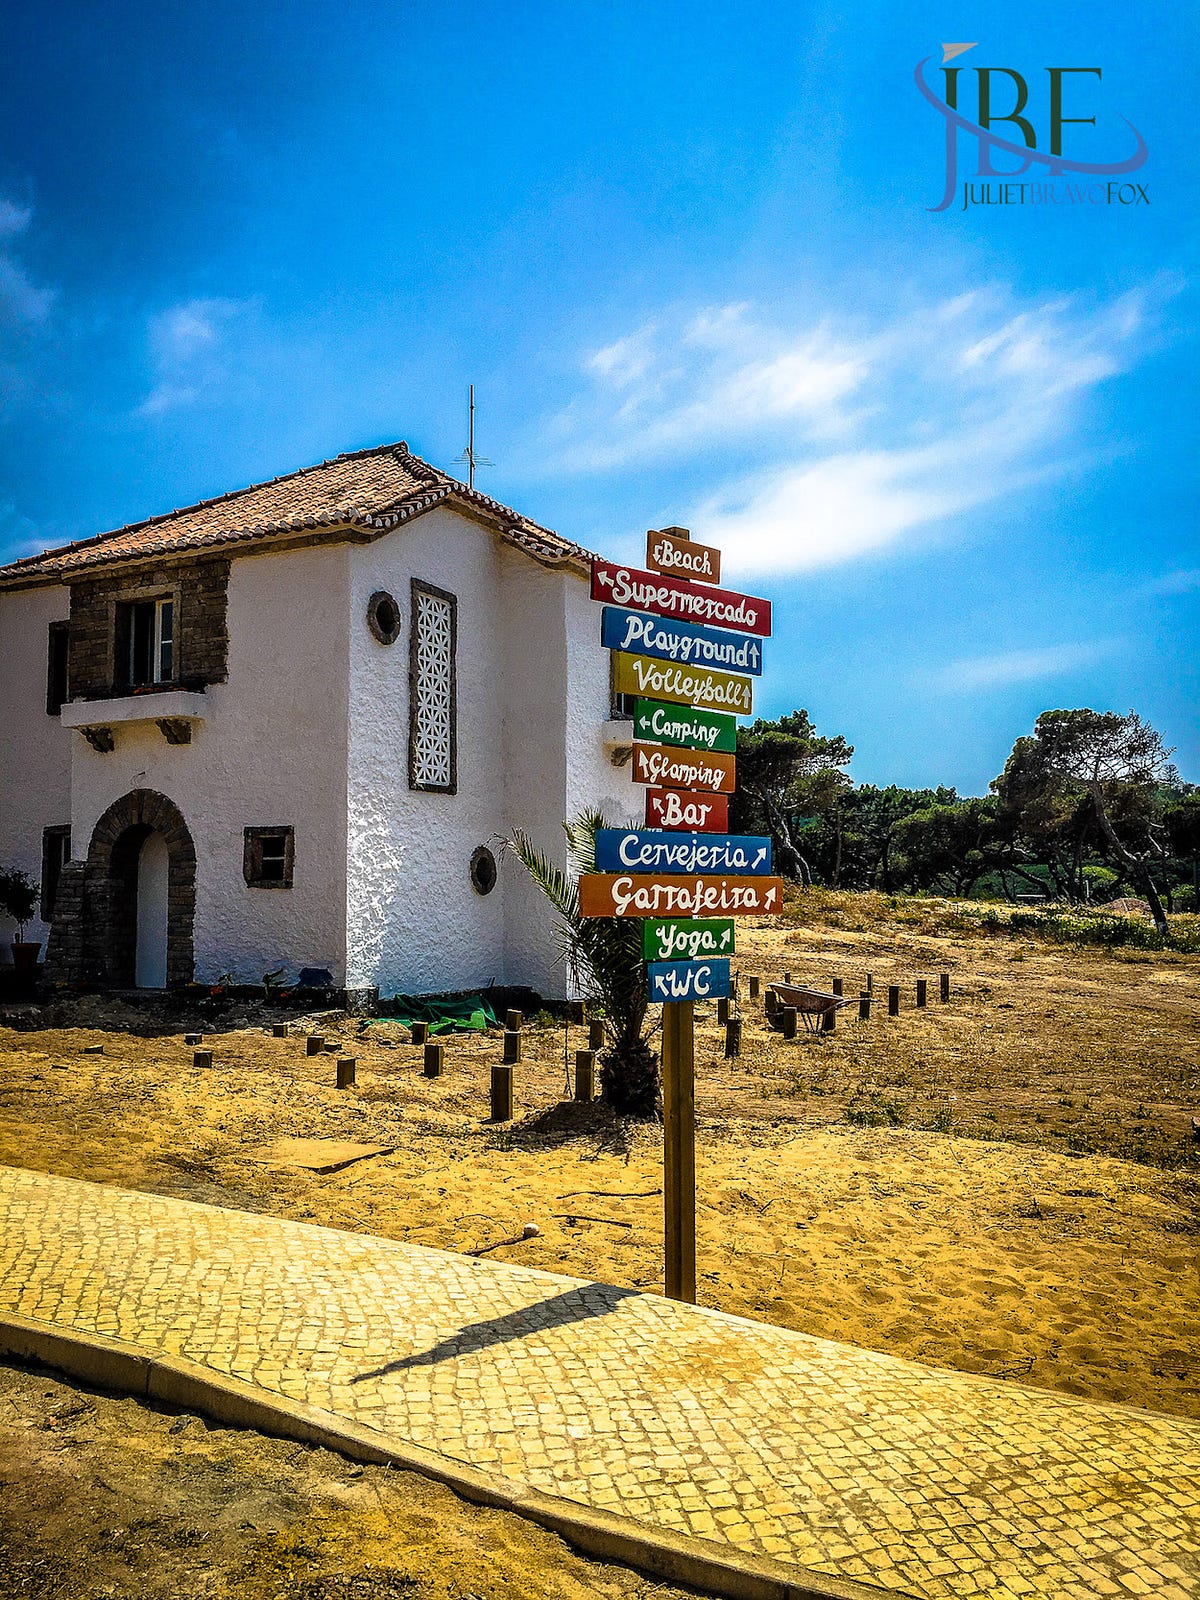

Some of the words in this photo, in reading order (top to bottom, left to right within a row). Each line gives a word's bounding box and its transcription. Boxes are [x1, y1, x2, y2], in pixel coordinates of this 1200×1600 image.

[659, 539, 713, 576] Beach
[612, 569, 758, 626] Supermercado
[620, 615, 749, 667] Playground
[633, 660, 742, 706] Volleyball
[652, 709, 721, 747] Camping
[649, 752, 726, 790] Glamping
[661, 793, 712, 826] Bar
[619, 834, 749, 872] Cervejeria
[612, 876, 760, 916] Garrafeira
[656, 924, 717, 958] Yoga
[666, 966, 711, 997] WC
